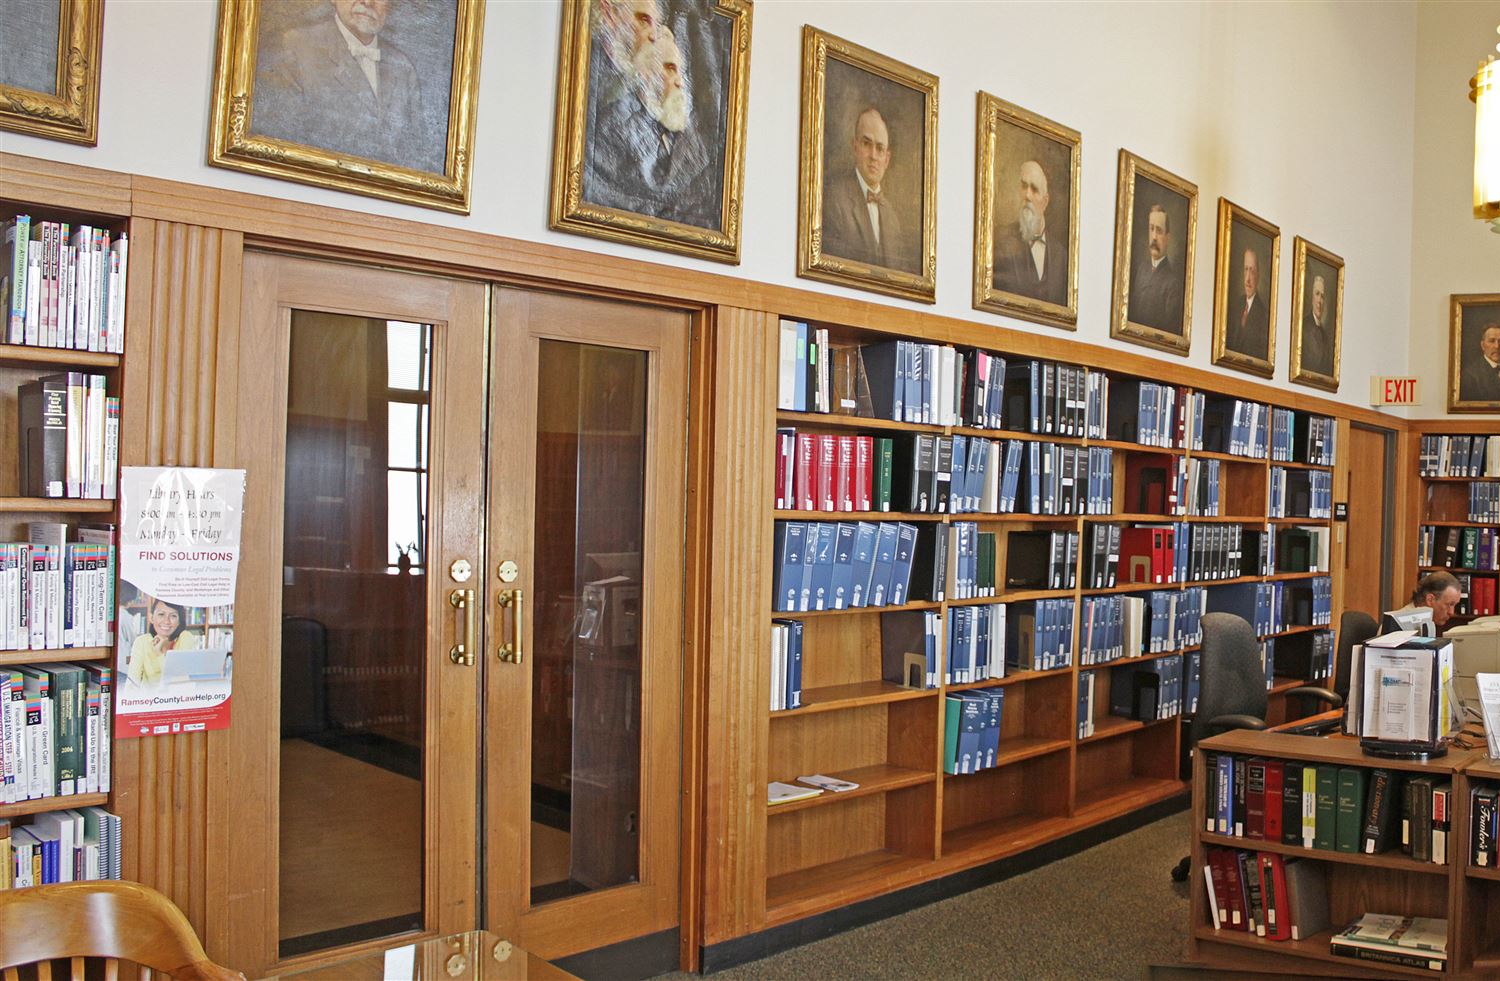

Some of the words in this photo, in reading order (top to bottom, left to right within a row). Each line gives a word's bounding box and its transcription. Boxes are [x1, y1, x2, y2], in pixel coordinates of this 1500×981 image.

[1385, 379, 1417, 403] EXIT
[149, 487, 181, 504] Libary
[187, 490, 215, 500] Hurs
[188, 510, 207, 519] 4:0
[191, 526, 221, 544] Friday
[139, 551, 166, 561] FIND
[170, 551, 233, 562] SOLUTIONS
[121, 692, 226, 706] RamseyCountyLawHelp.org
[4, 703, 12, 740] IMMIGRATION
[1371, 777, 1386, 826] dictionary
[1480, 805, 1490, 850] Fowler's
